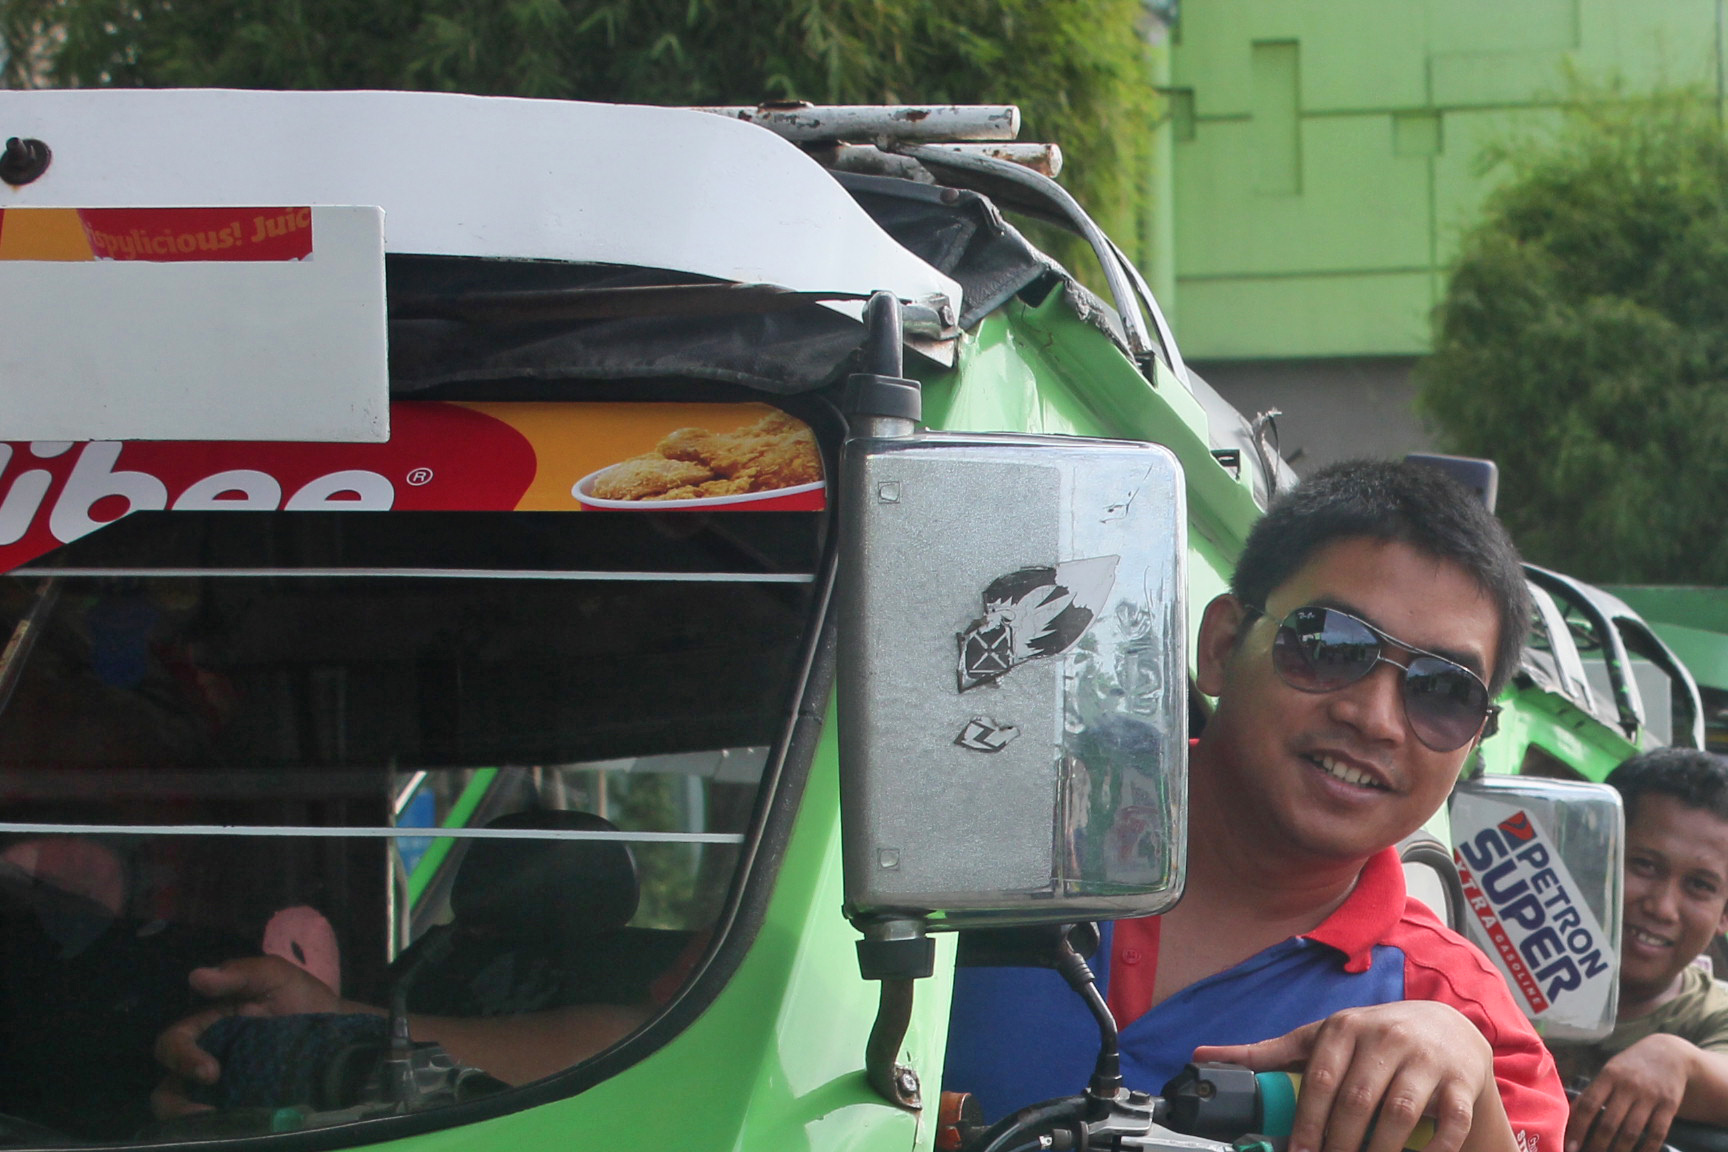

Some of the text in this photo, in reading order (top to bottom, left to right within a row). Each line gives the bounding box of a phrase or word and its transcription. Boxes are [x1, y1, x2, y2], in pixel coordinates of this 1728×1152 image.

[251, 207, 310, 242] Juic
[0, 441, 394, 545] ibee
[1459, 828, 1582, 1004] SUPER
[1516, 843, 1608, 979] PETRON
[1494, 934, 1542, 1005] GASOLINE
